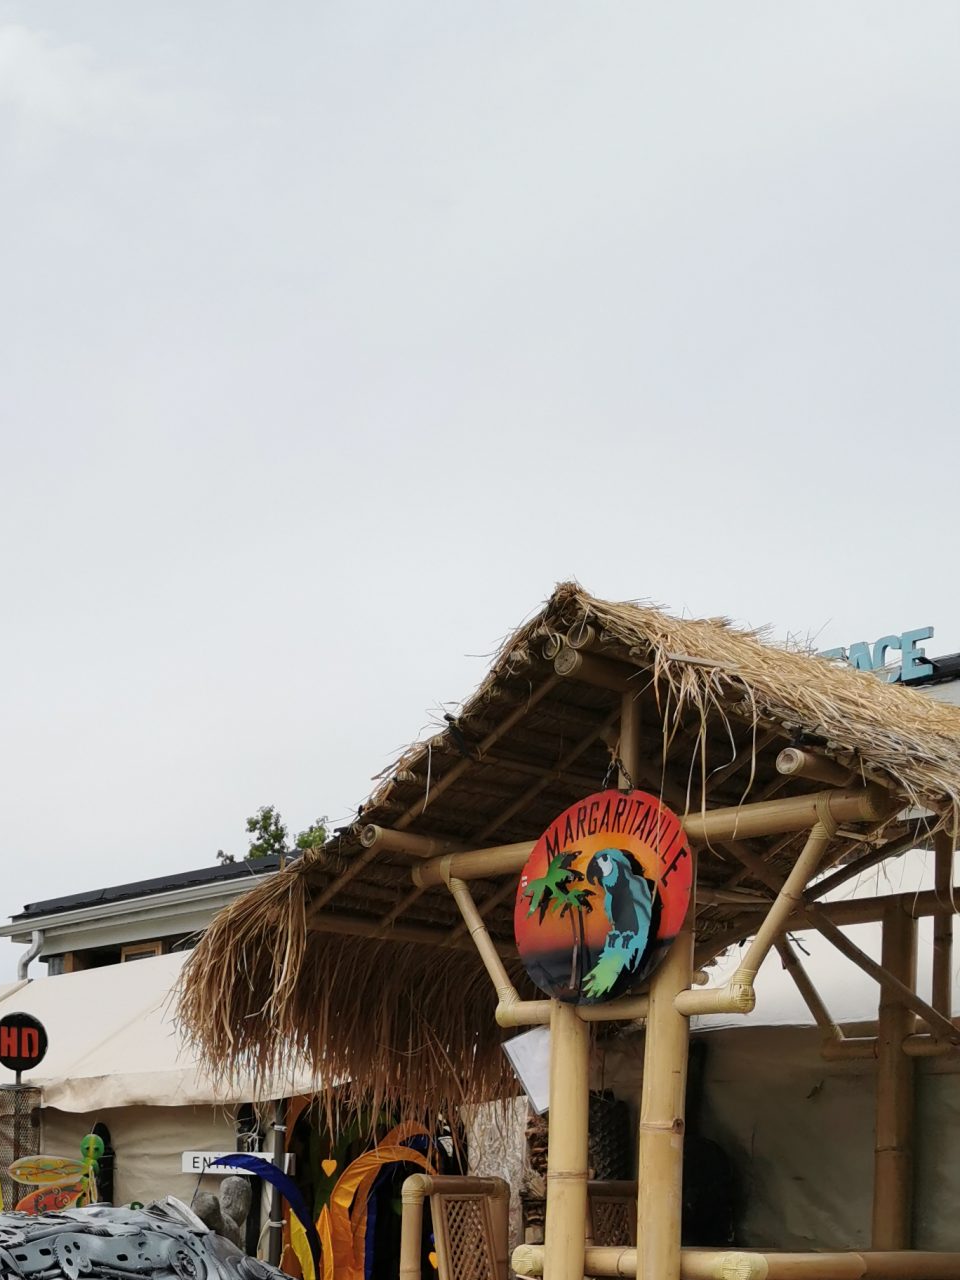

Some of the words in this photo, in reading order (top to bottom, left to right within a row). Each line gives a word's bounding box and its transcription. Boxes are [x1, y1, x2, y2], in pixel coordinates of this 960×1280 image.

[815, 626, 934, 683] ACE
[545, 798, 687, 887] MARGARITAVILLE
[0, 1026, 38, 1058] HD
